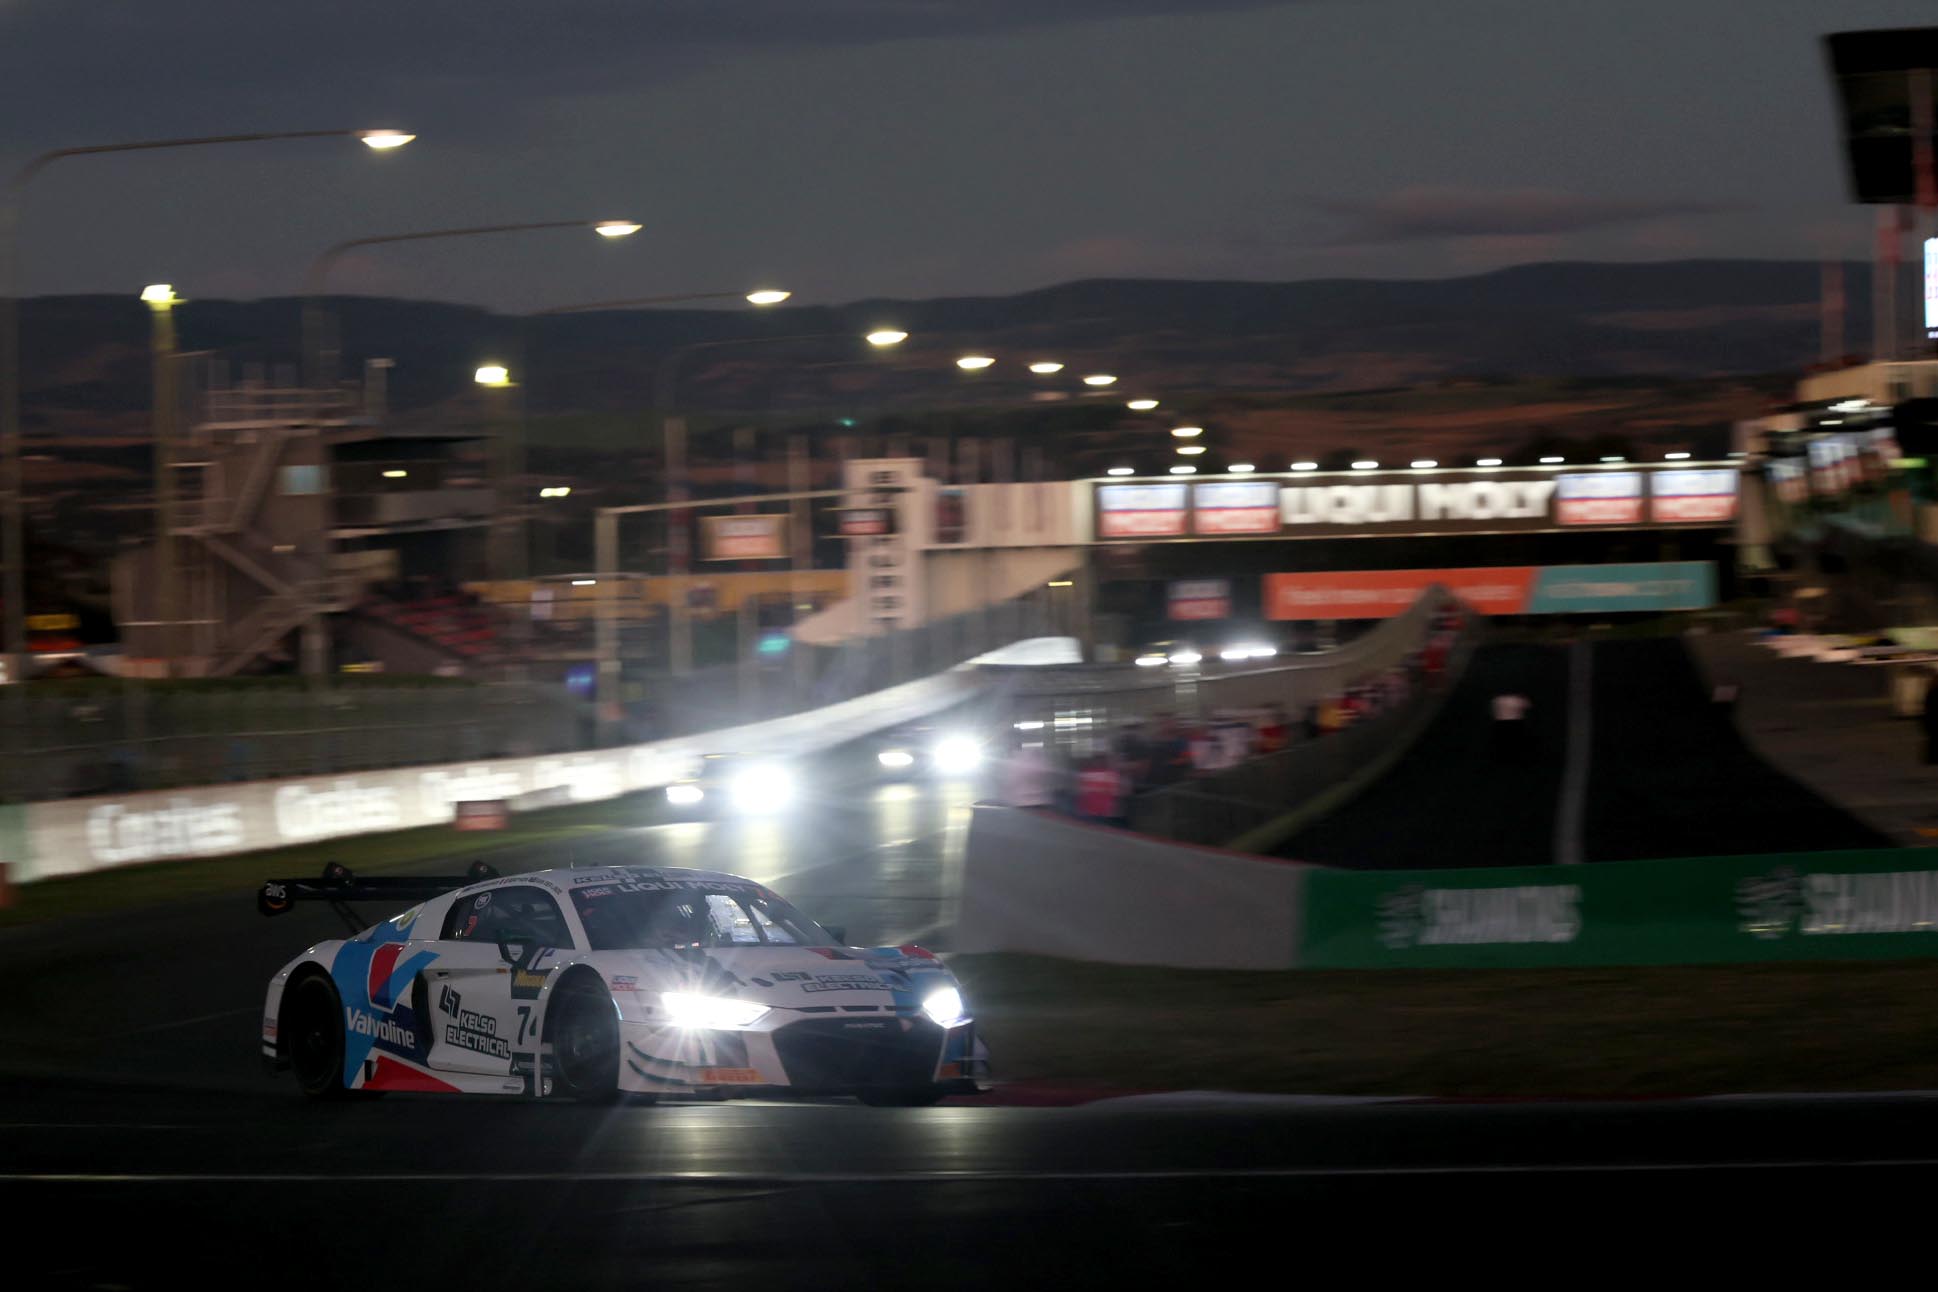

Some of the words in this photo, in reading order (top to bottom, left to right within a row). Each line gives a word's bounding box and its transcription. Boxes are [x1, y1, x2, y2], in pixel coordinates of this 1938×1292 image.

[1417, 481, 1555, 519] MOLY
[616, 880, 683, 894] LIQUI
[345, 1006, 416, 1050] Valvoline
[460, 1012, 496, 1035] KELSO
[446, 1026, 512, 1060] ELECTRICAL
